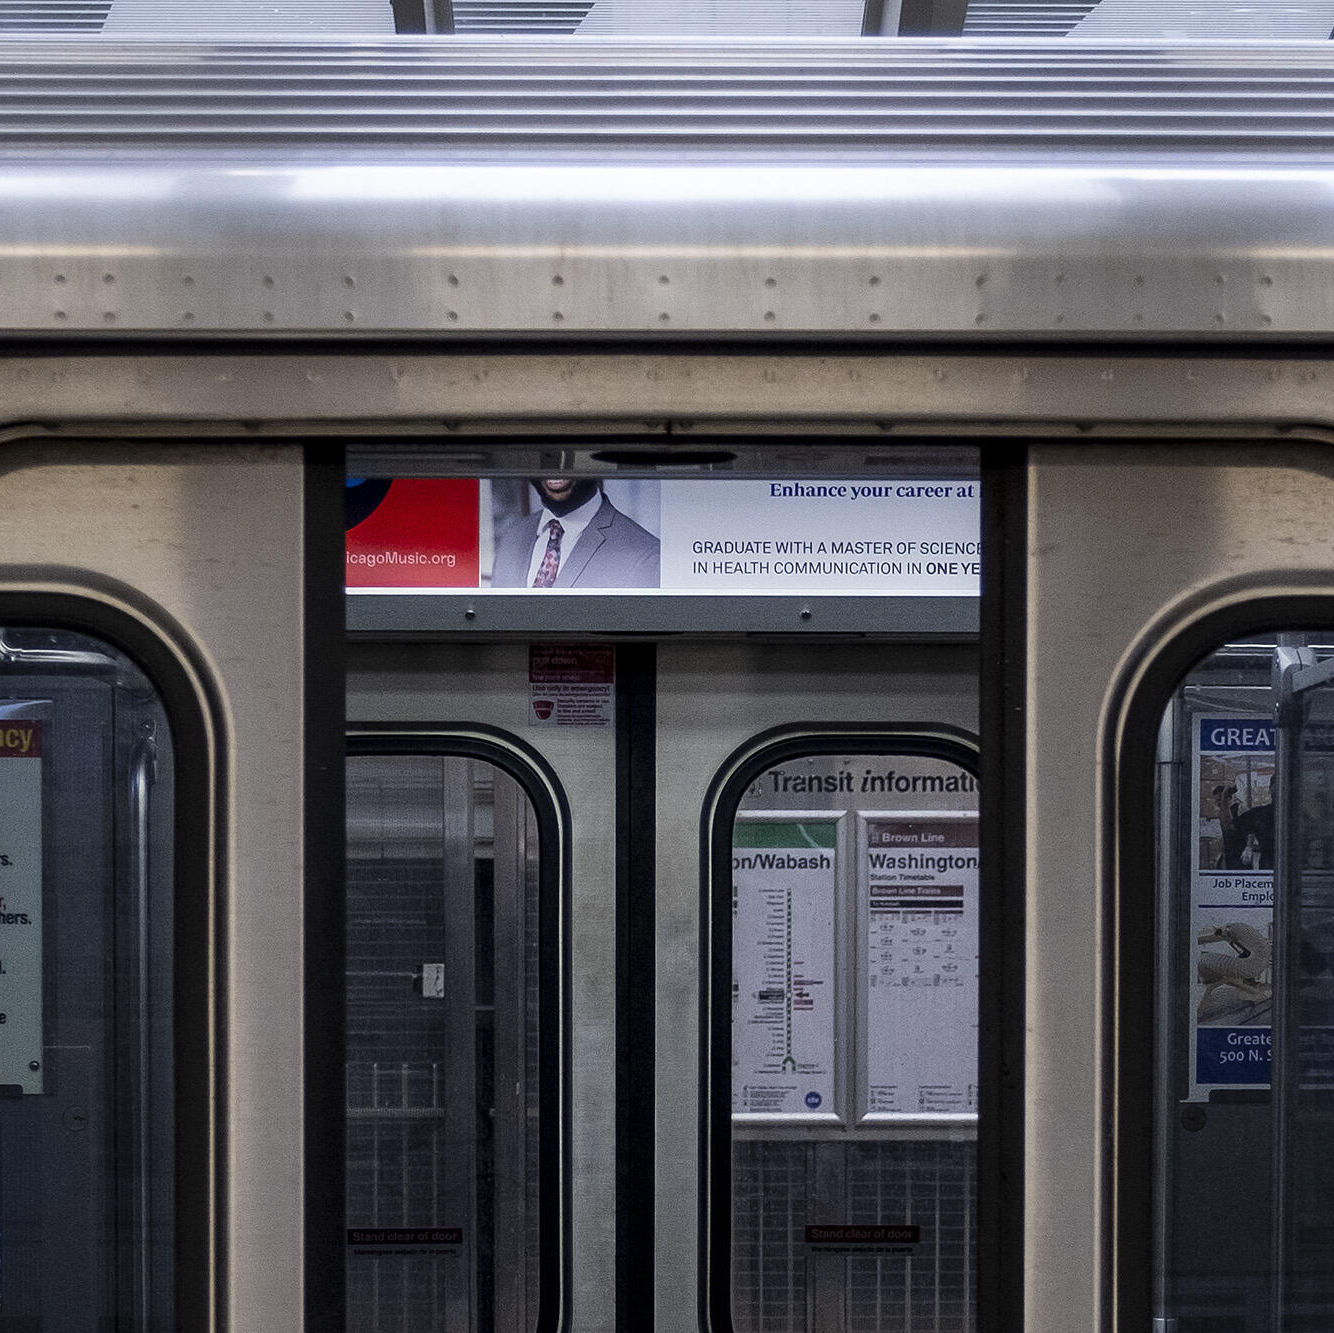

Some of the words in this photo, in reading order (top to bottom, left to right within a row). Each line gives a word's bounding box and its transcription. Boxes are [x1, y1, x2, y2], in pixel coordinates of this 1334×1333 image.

[769, 482, 847, 498] Enhance
[851, 485, 892, 501] your
[896, 485, 952, 498] career
[957, 484, 975, 498] at
[692, 541, 772, 554] GRADUATE
[775, 541, 813, 554] WITH
[817, 541, 827, 554] A
[831, 541, 893, 554] MASTER
[896, 542, 917, 554] OF
[346, 551, 456, 567] icagoMusic.org
[693, 561, 708, 574] IN
[713, 561, 769, 574] HEALTH
[774, 561, 902, 575] COMMUNICATION
[907, 562, 922, 574] IN
[926, 562, 958, 575] ONE
[961, 562, 980, 575] YE
[768, 770, 854, 793] Transit
[882, 832, 918, 843] Brown
[921, 832, 945, 843] Line
[869, 853, 979, 873] Washington
[1213, 879, 1232, 888] Job
[1219, 1051, 1244, 1064] 500
[1249, 1049, 1263, 1061] N.
[352, 1231, 385, 1241] Stand
[387, 1231, 414, 1241] clear
[417, 1231, 428, 1241] of
[432, 1231, 459, 1241] door
[811, 1228, 843, 1239] Stand
[845, 1228, 871, 1239] clear
[874, 1228, 886, 1239] of
[888, 1228, 914, 1239] door
